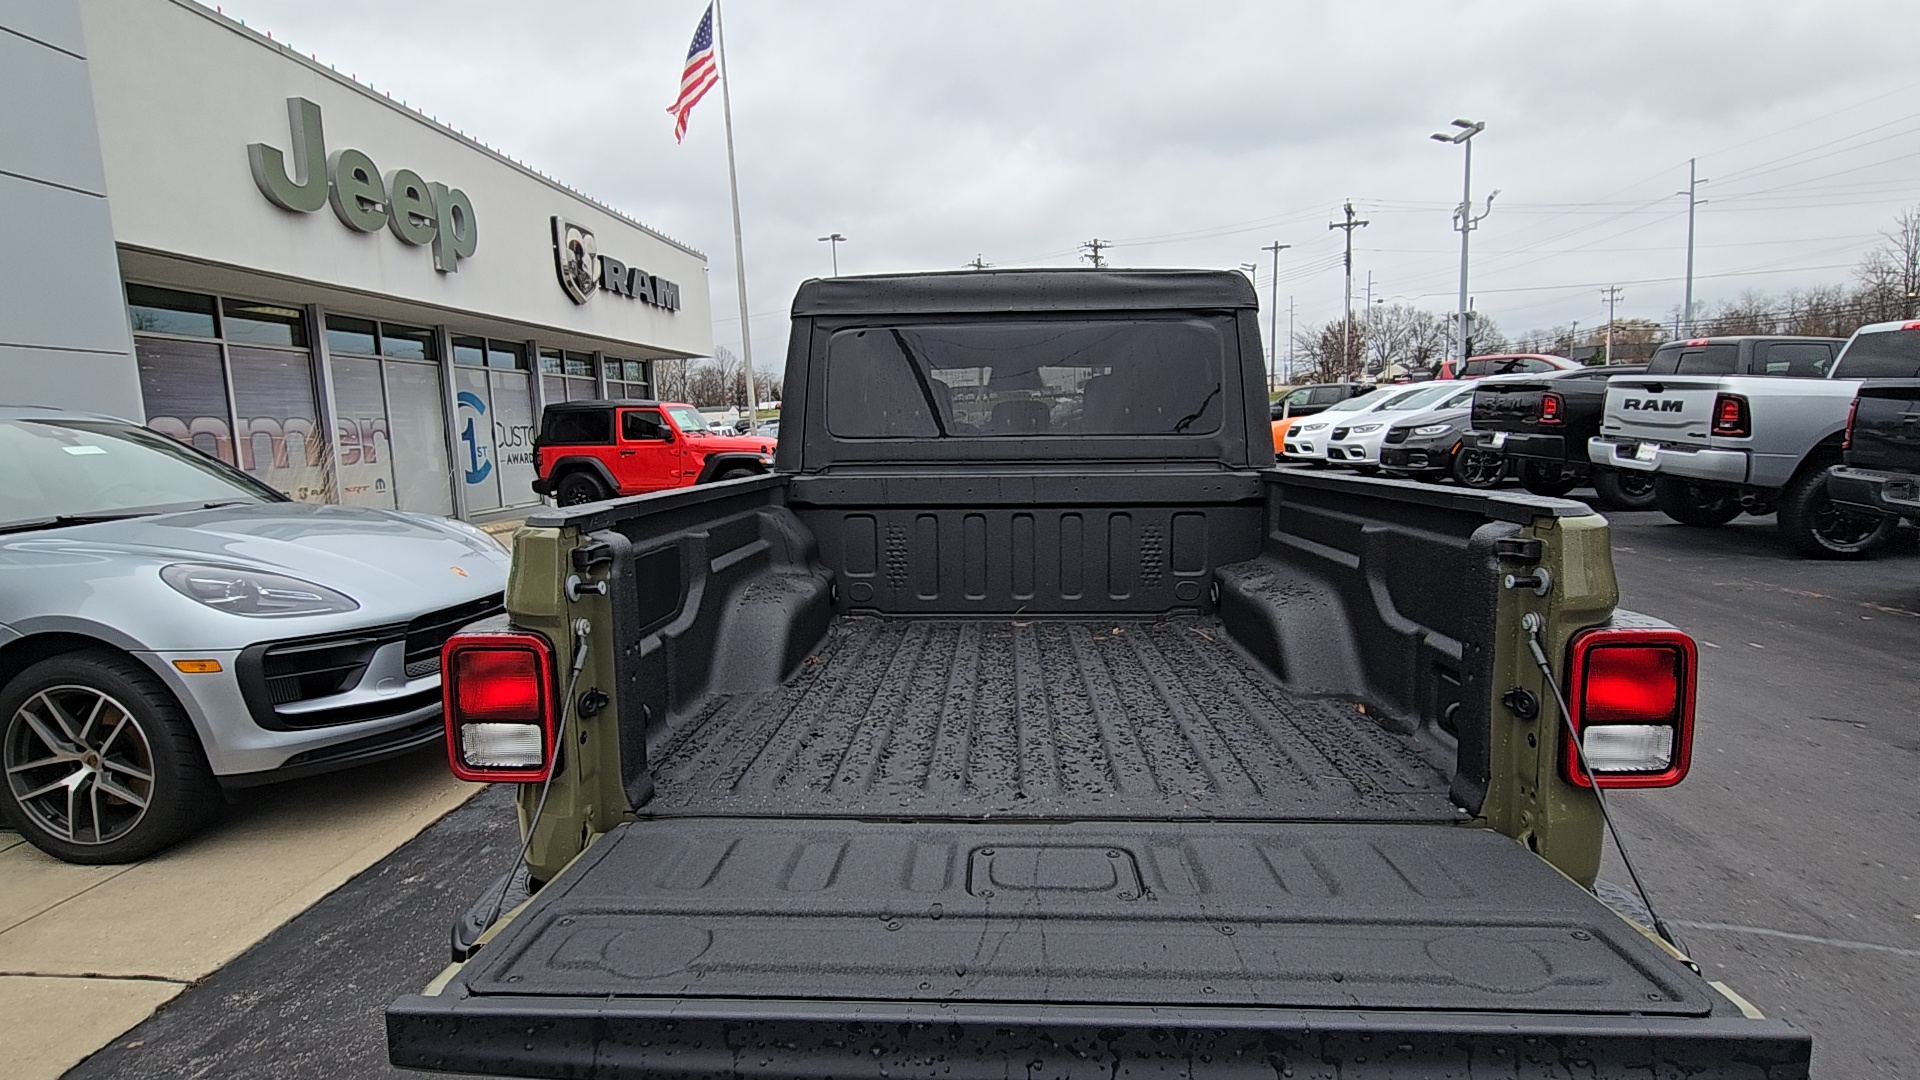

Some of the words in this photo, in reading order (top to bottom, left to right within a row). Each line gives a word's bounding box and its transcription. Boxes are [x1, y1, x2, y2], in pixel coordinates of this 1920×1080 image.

[247, 98, 478, 273] Jeep
[597, 254, 681, 311] RAM
[1623, 398, 1684, 413] RAM
